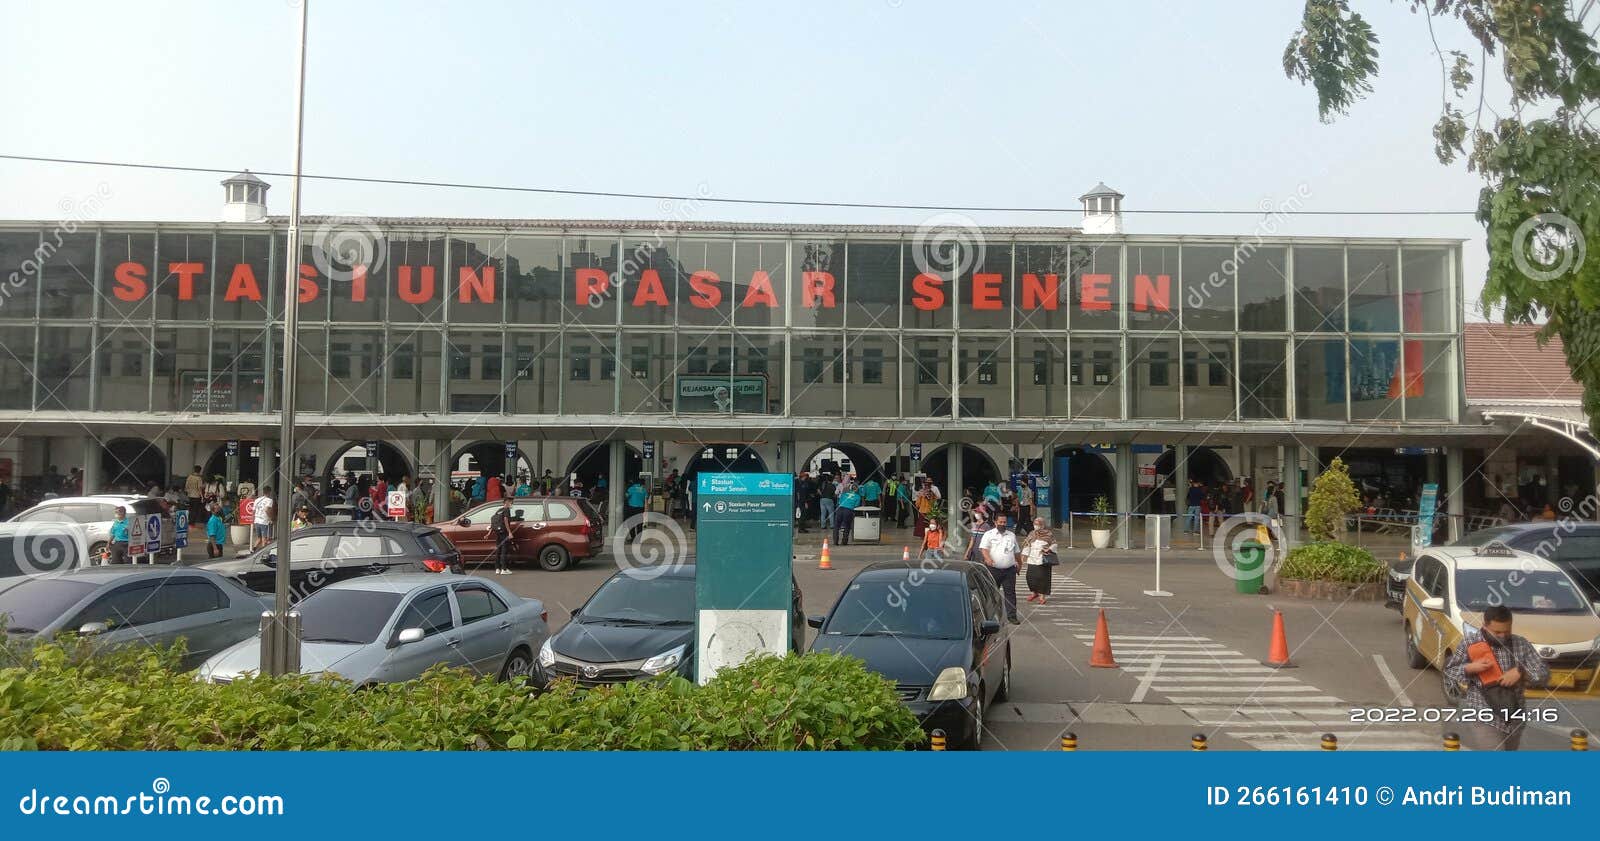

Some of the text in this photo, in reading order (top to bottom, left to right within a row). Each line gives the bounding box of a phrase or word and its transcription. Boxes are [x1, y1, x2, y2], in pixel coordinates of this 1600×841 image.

[113, 262, 1170, 311] STASIUN PASAR SENEN
